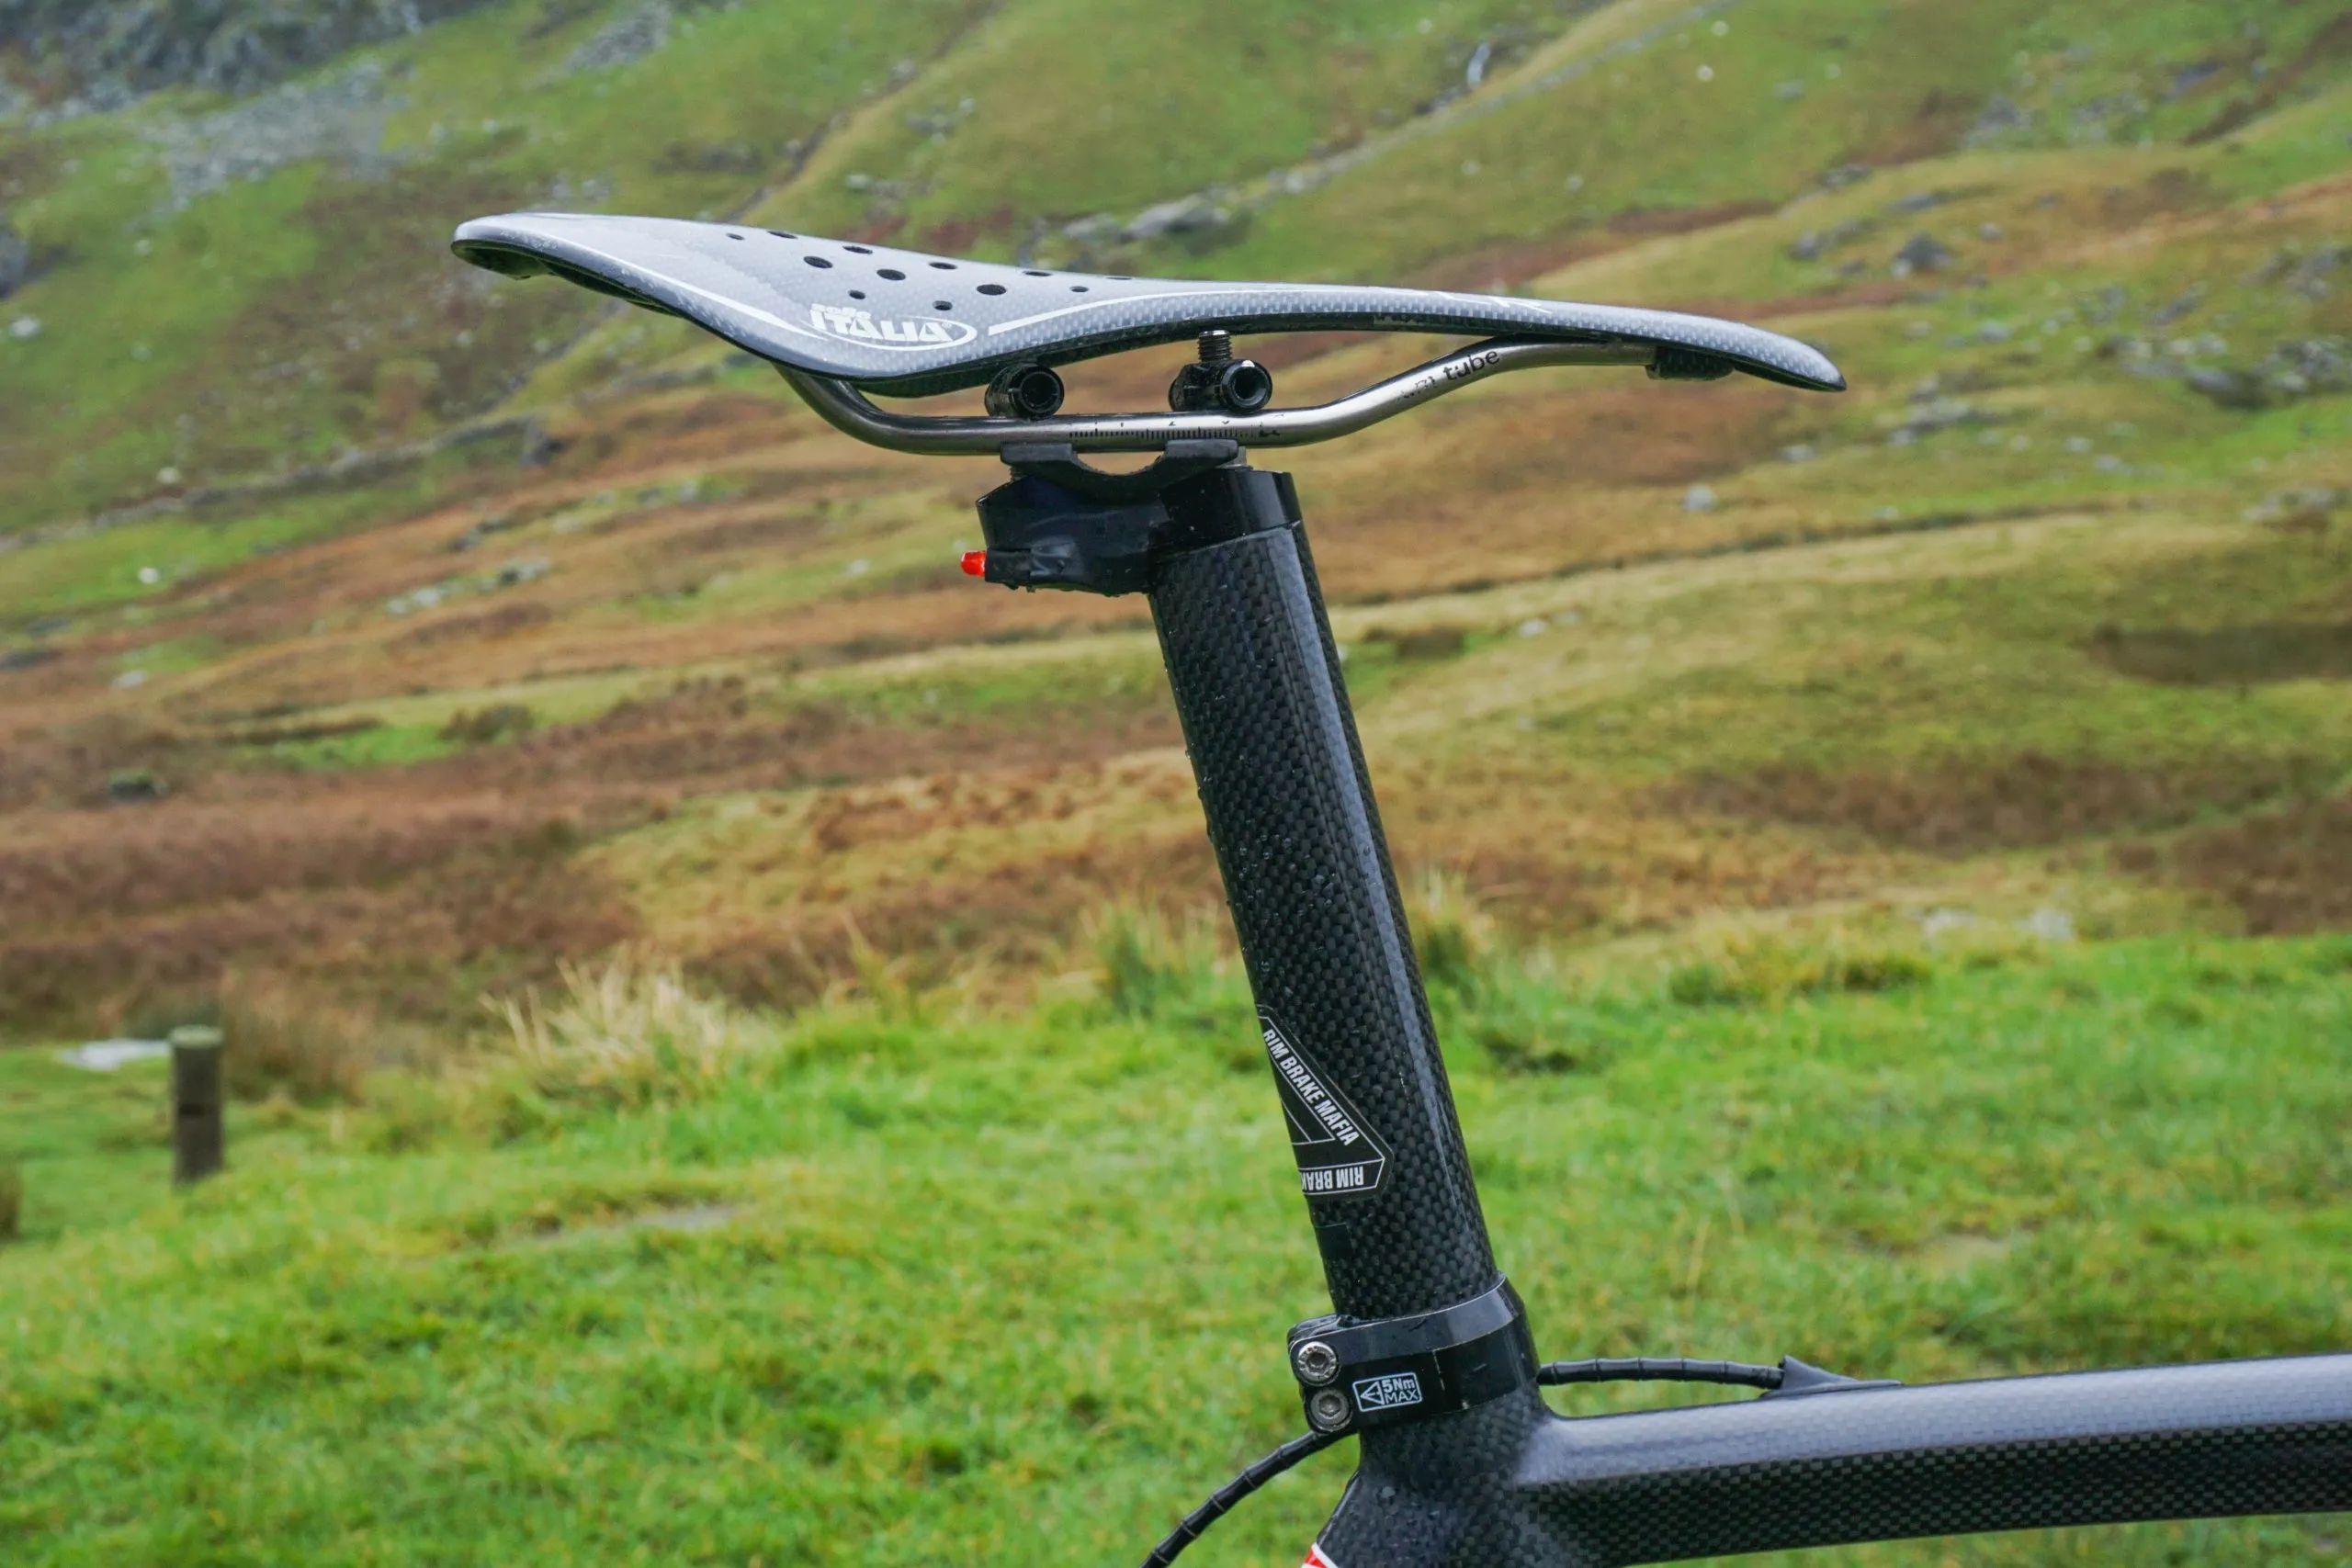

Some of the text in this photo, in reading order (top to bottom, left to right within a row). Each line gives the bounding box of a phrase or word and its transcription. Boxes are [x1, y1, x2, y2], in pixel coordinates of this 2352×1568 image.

[809, 310, 953, 342] ITALIA
[1443, 350, 1500, 381] tube
[1263, 1029, 1360, 1145] RIM BRAKE MAFIA
[1336, 1166, 1364, 1189] RIM
[1382, 1378, 1415, 1393] 5Nm
[1385, 1390, 1418, 1404] MAX
